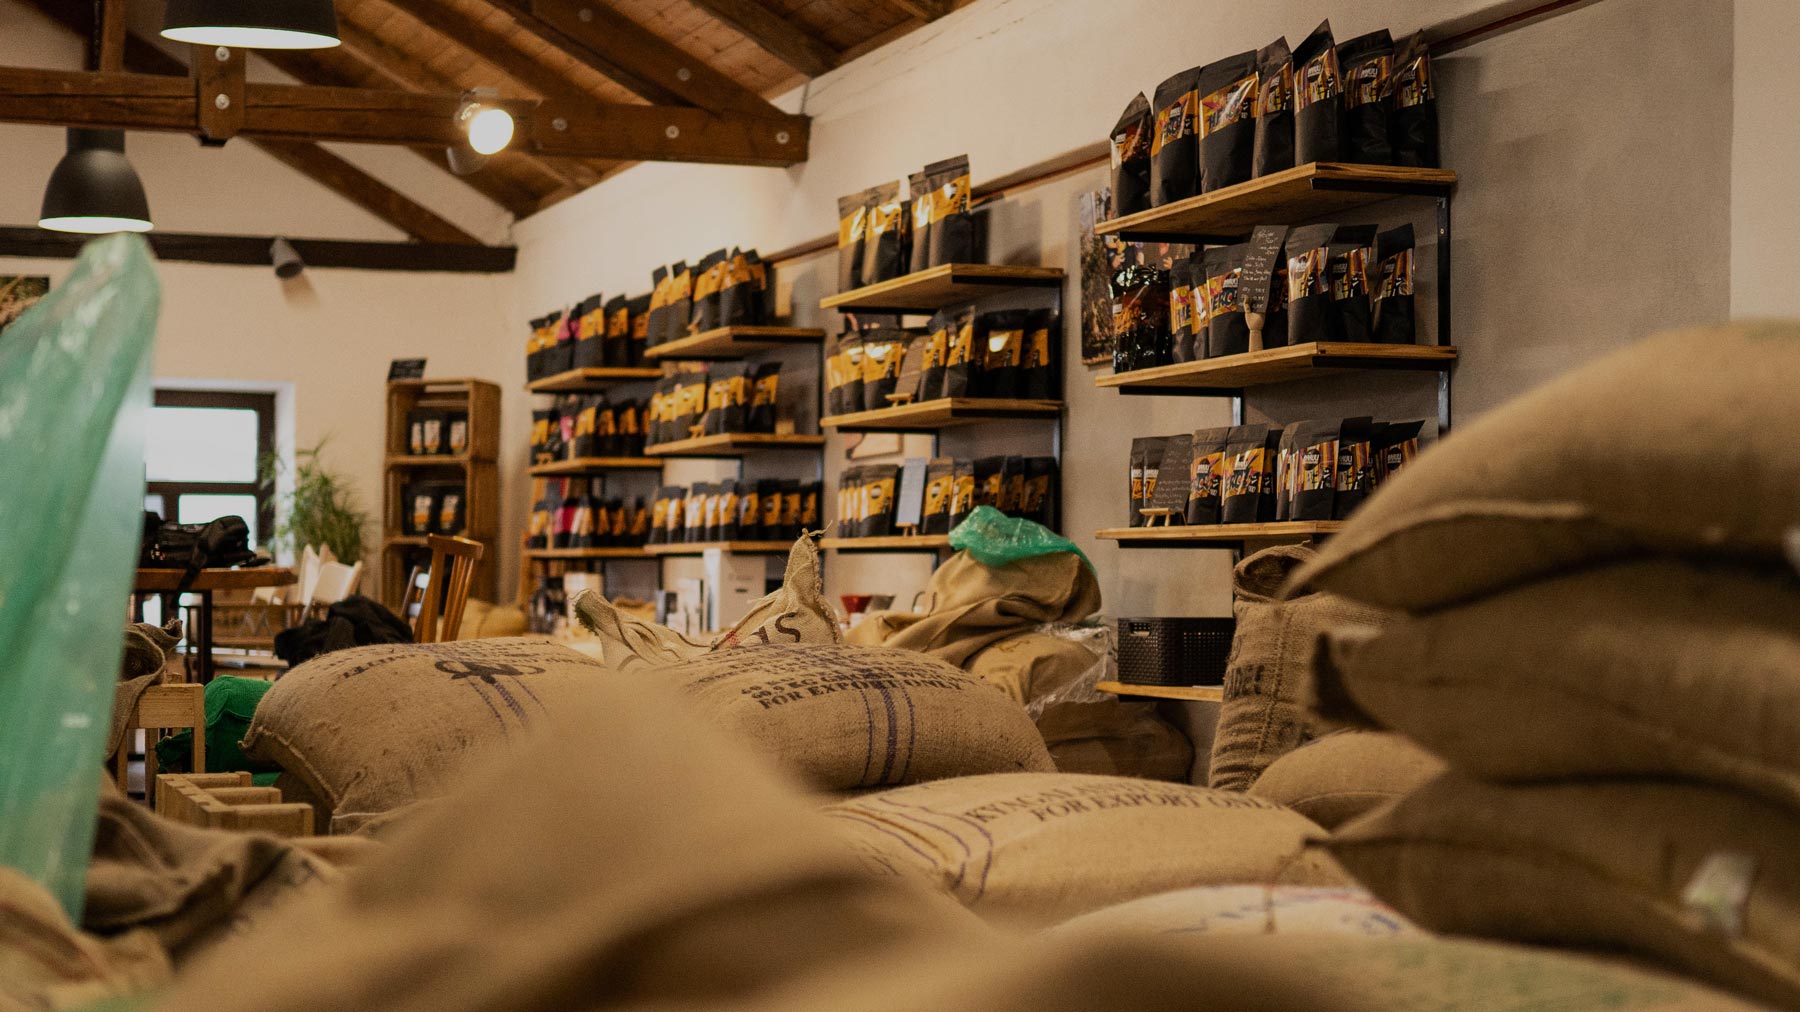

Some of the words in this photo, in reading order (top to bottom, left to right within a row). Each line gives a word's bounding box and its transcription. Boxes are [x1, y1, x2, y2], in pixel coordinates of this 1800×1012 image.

[758, 690, 804, 709] FOR
[807, 680, 897, 697] EXPORT
[904, 679, 962, 691] ONLY
[1030, 799, 1089, 822] FOR
[1090, 793, 1199, 810] EXPORT
